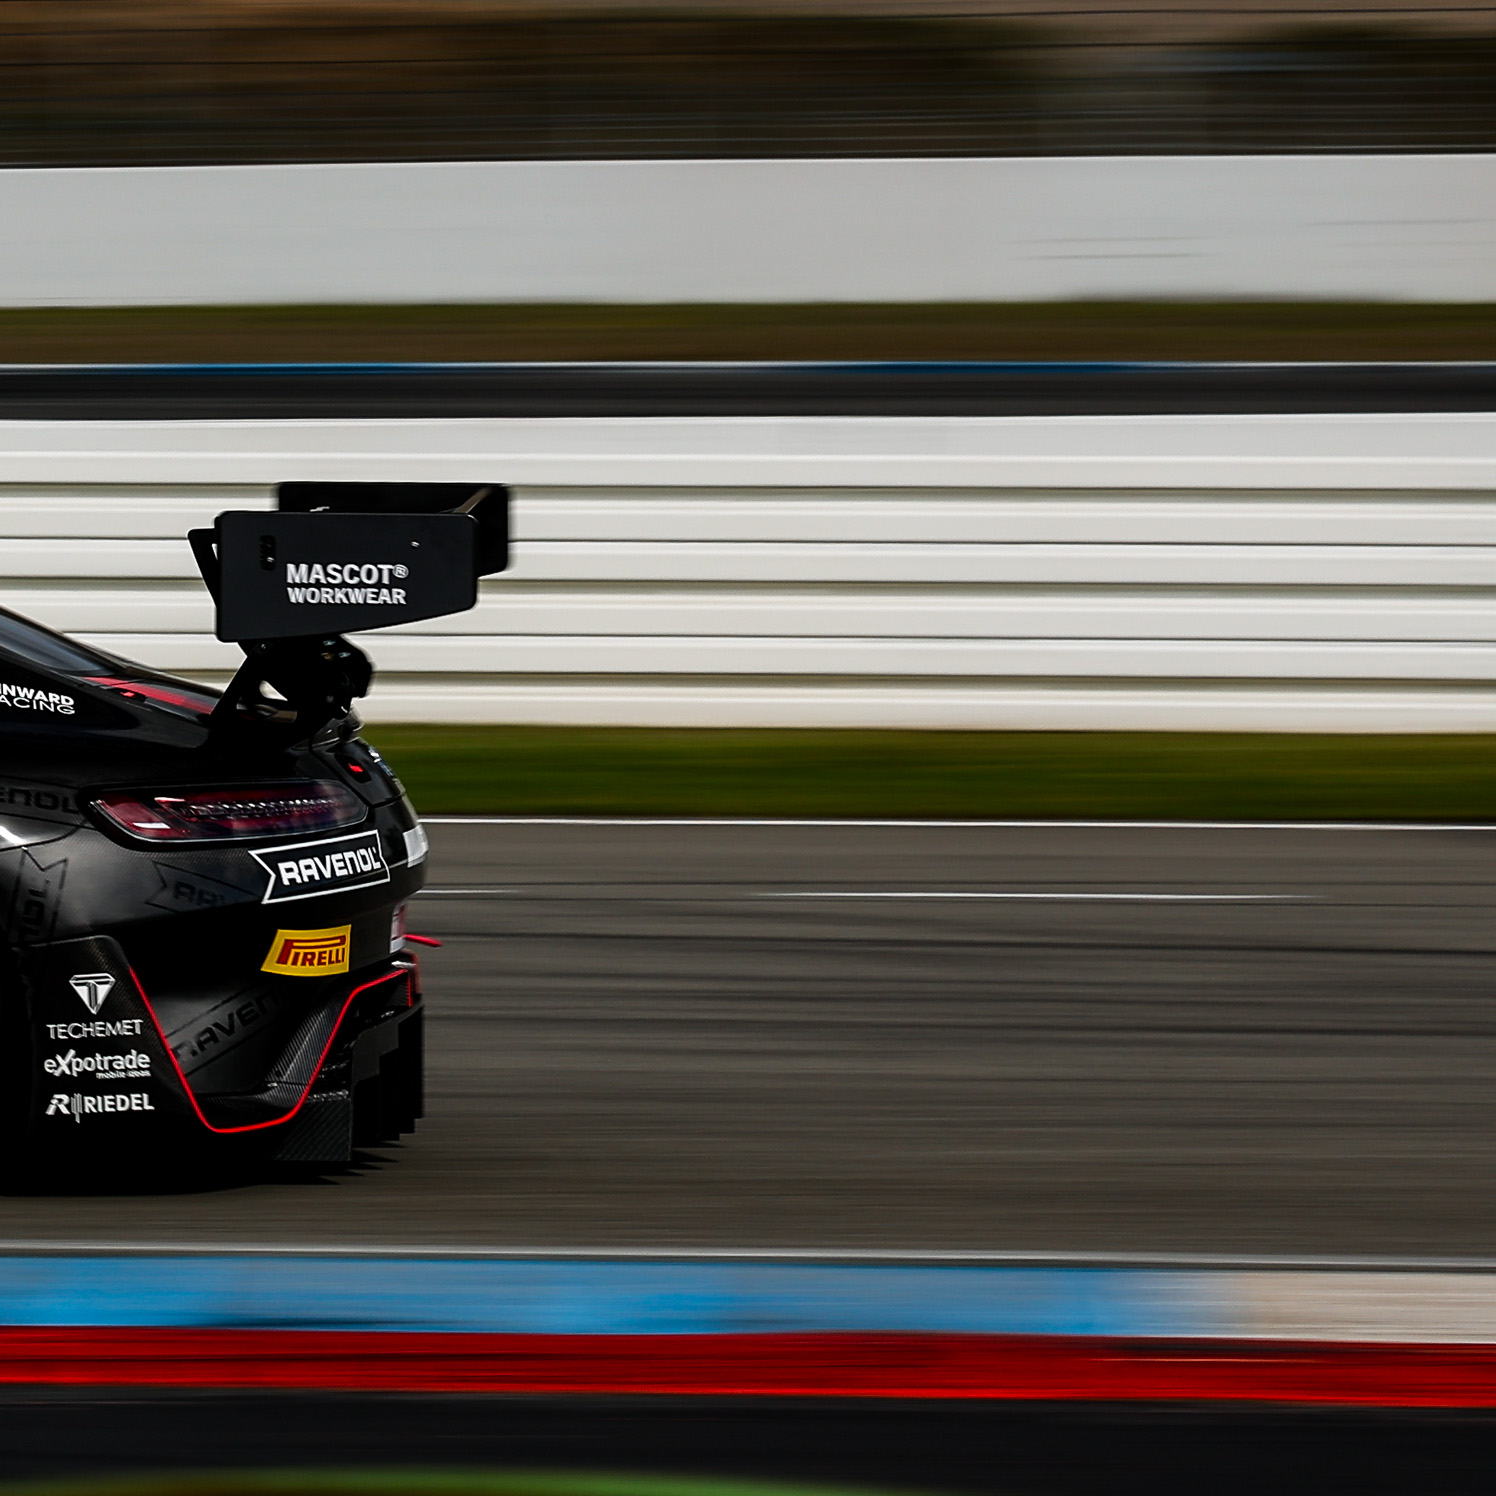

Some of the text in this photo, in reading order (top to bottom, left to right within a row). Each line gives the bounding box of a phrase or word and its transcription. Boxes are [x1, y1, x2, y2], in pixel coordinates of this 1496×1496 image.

[286, 587, 408, 605] WORKWEAR
[277, 846, 382, 886] RAVENOL
[275, 934, 347, 967] PIRELLI
[46, 1019, 144, 1040] TECHEMET
[83, 1093, 155, 1113] RIEDEL
